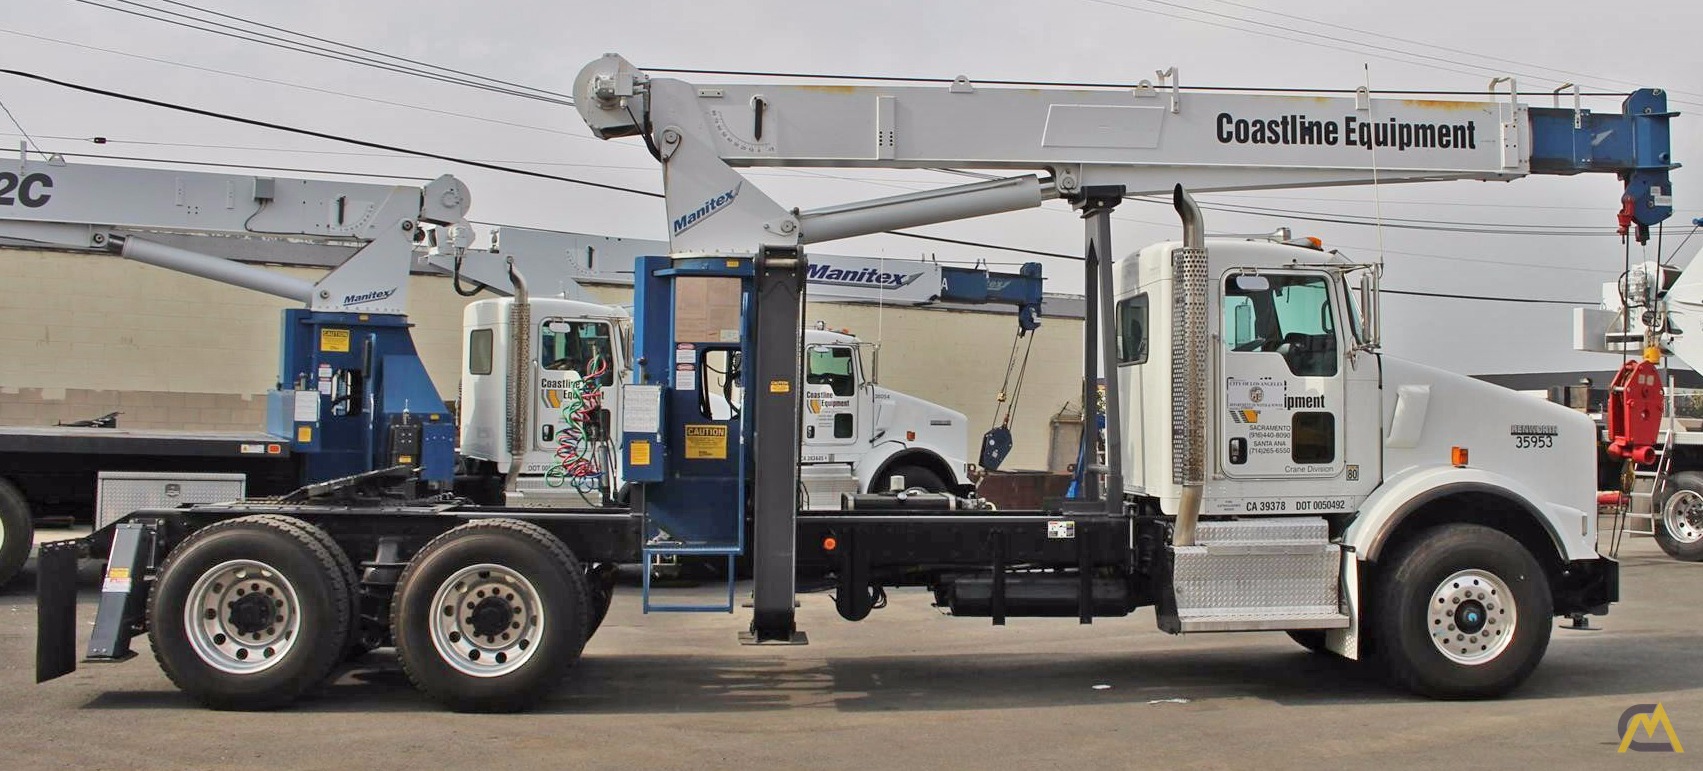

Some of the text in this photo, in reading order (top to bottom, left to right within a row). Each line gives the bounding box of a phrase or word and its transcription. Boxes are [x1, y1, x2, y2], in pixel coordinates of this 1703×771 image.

[1216, 112, 1476, 150] Coastline Equipment
[0, 171, 53, 208] 2C
[673, 189, 735, 233] Manitex
[806, 264, 907, 285] Manitex
[343, 290, 391, 304] Manitex
[806, 391, 833, 399] Coastline
[821, 400, 850, 408] Equipment
[1284, 394, 1325, 410] ipment
[687, 428, 725, 436] CAUTION
[1515, 436, 1553, 448] 35953
[1249, 447, 1291, 455] (714)265-6550
[1284, 465, 1334, 473] Crane Division
[1347, 468, 1358, 479] 80
[1246, 501, 1258, 511] CA
[1260, 501, 1286, 511] 39378
[1296, 501, 1311, 510] DOT
[1313, 501, 1345, 510] 0050492
